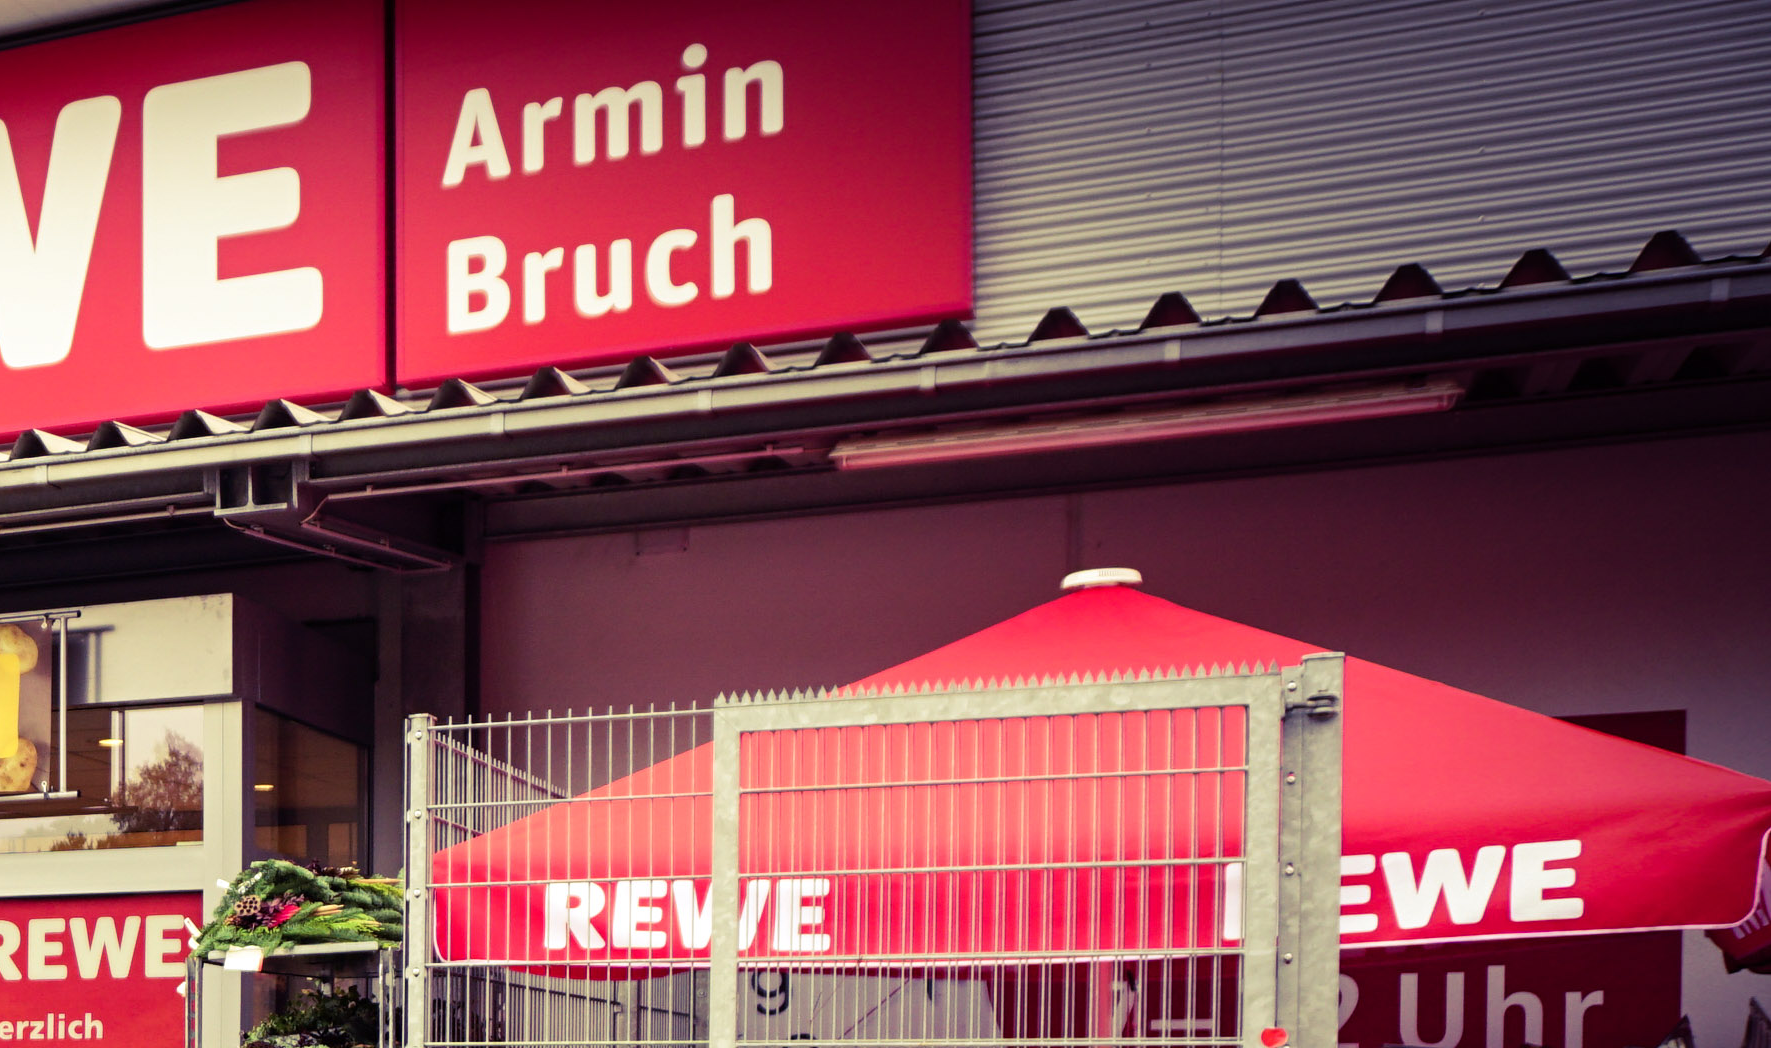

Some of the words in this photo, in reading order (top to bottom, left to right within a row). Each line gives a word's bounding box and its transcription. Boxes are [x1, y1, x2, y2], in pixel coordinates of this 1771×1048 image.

[440, 43, 784, 188] Armin
[445, 192, 774, 335] Bruch
[543, 877, 832, 954] REWE
[1223, 839, 1584, 941] EWE
